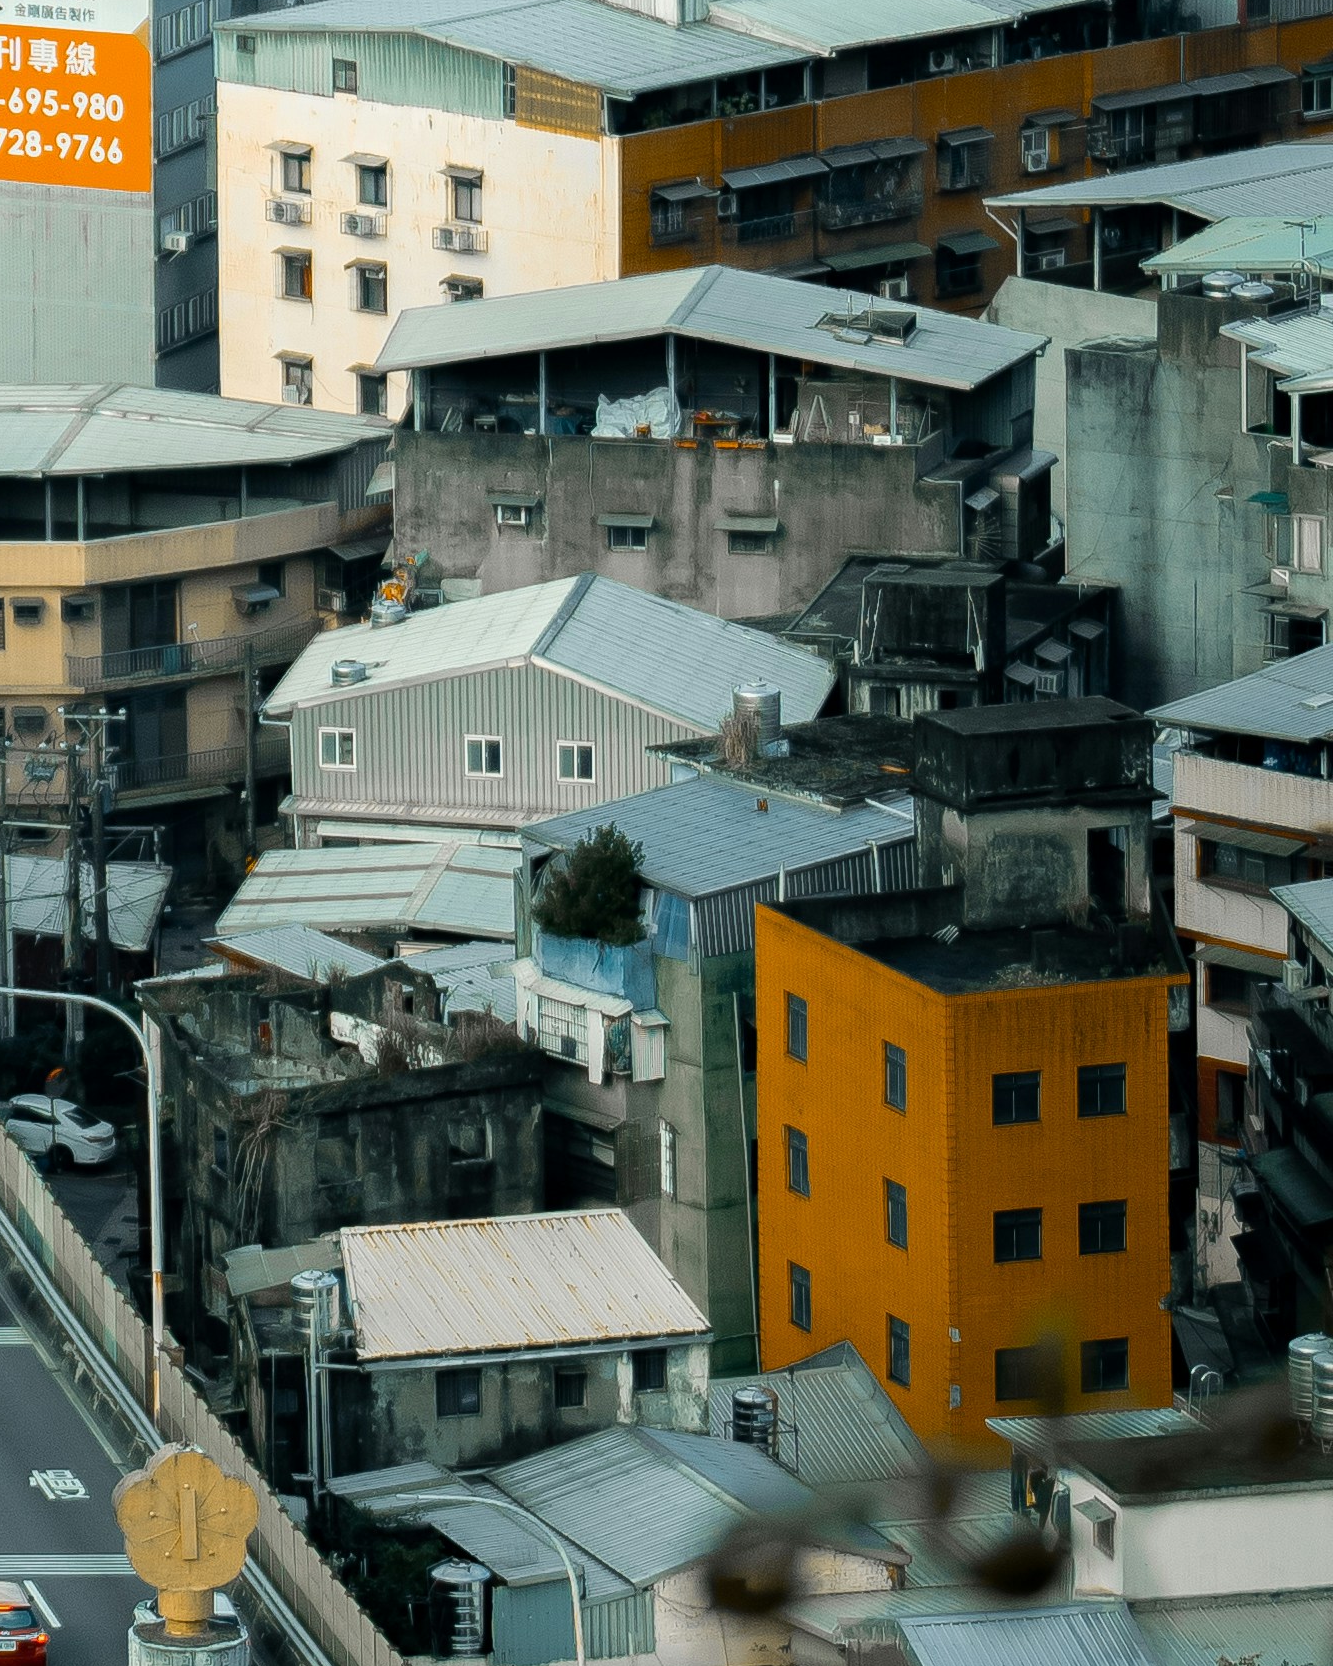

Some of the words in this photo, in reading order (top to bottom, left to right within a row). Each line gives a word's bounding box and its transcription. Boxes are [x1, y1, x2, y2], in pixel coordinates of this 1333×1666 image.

[14, 3, 96, 23] 金剛廣告製作
[29, 1470, 90, 1502] 慢
